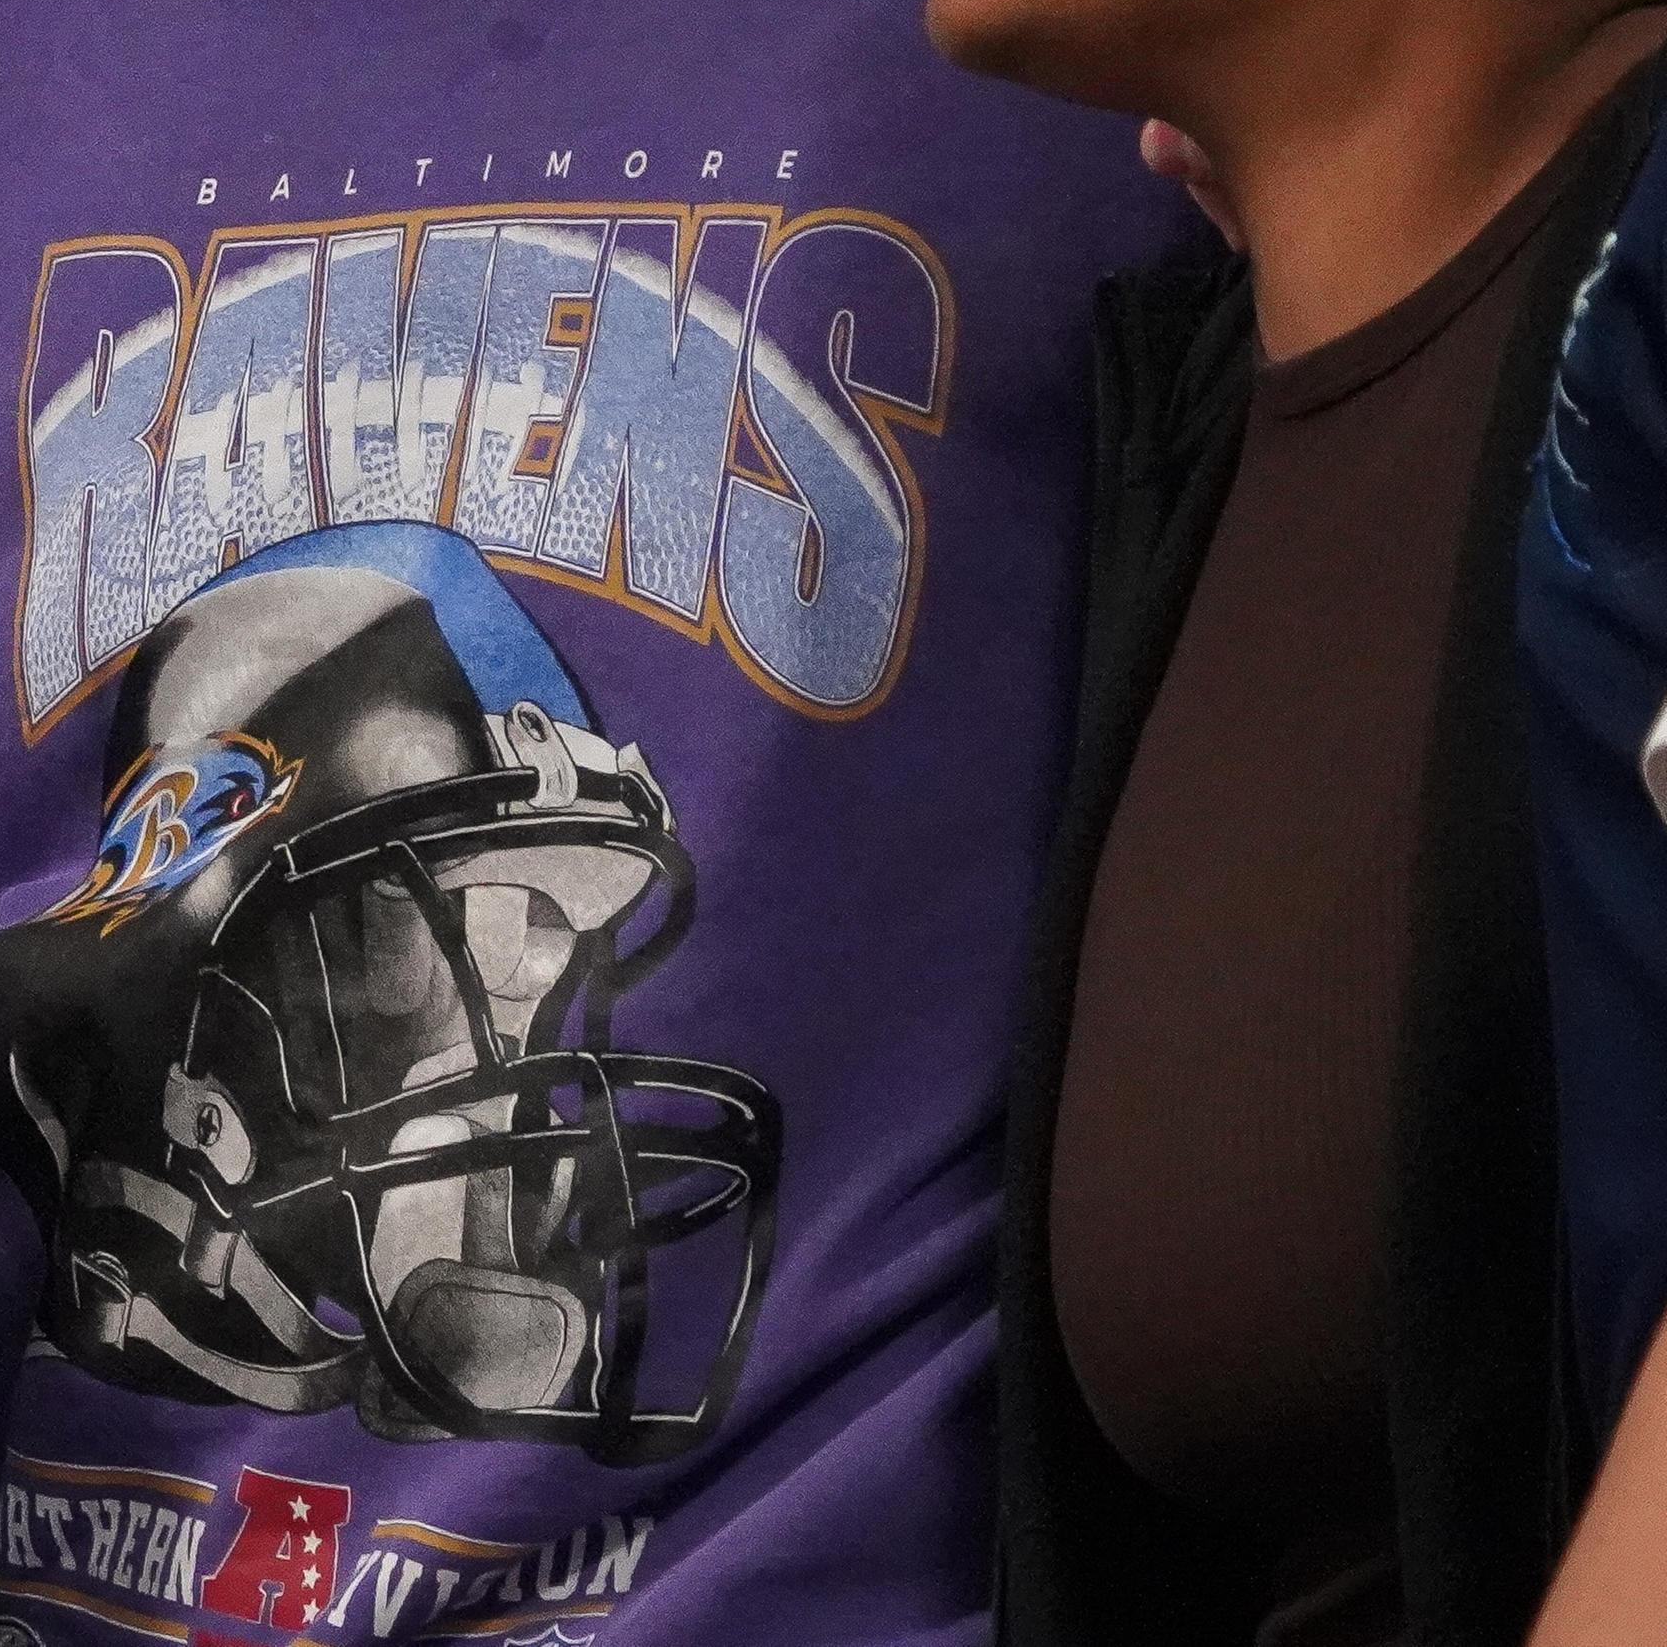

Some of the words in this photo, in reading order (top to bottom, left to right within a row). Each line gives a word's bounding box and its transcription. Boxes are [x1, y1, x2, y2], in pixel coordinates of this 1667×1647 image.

[197, 149, 800, 206] BALTIMORE
[13, 199, 957, 744] RAVENS
[95, 762, 199, 900] B
